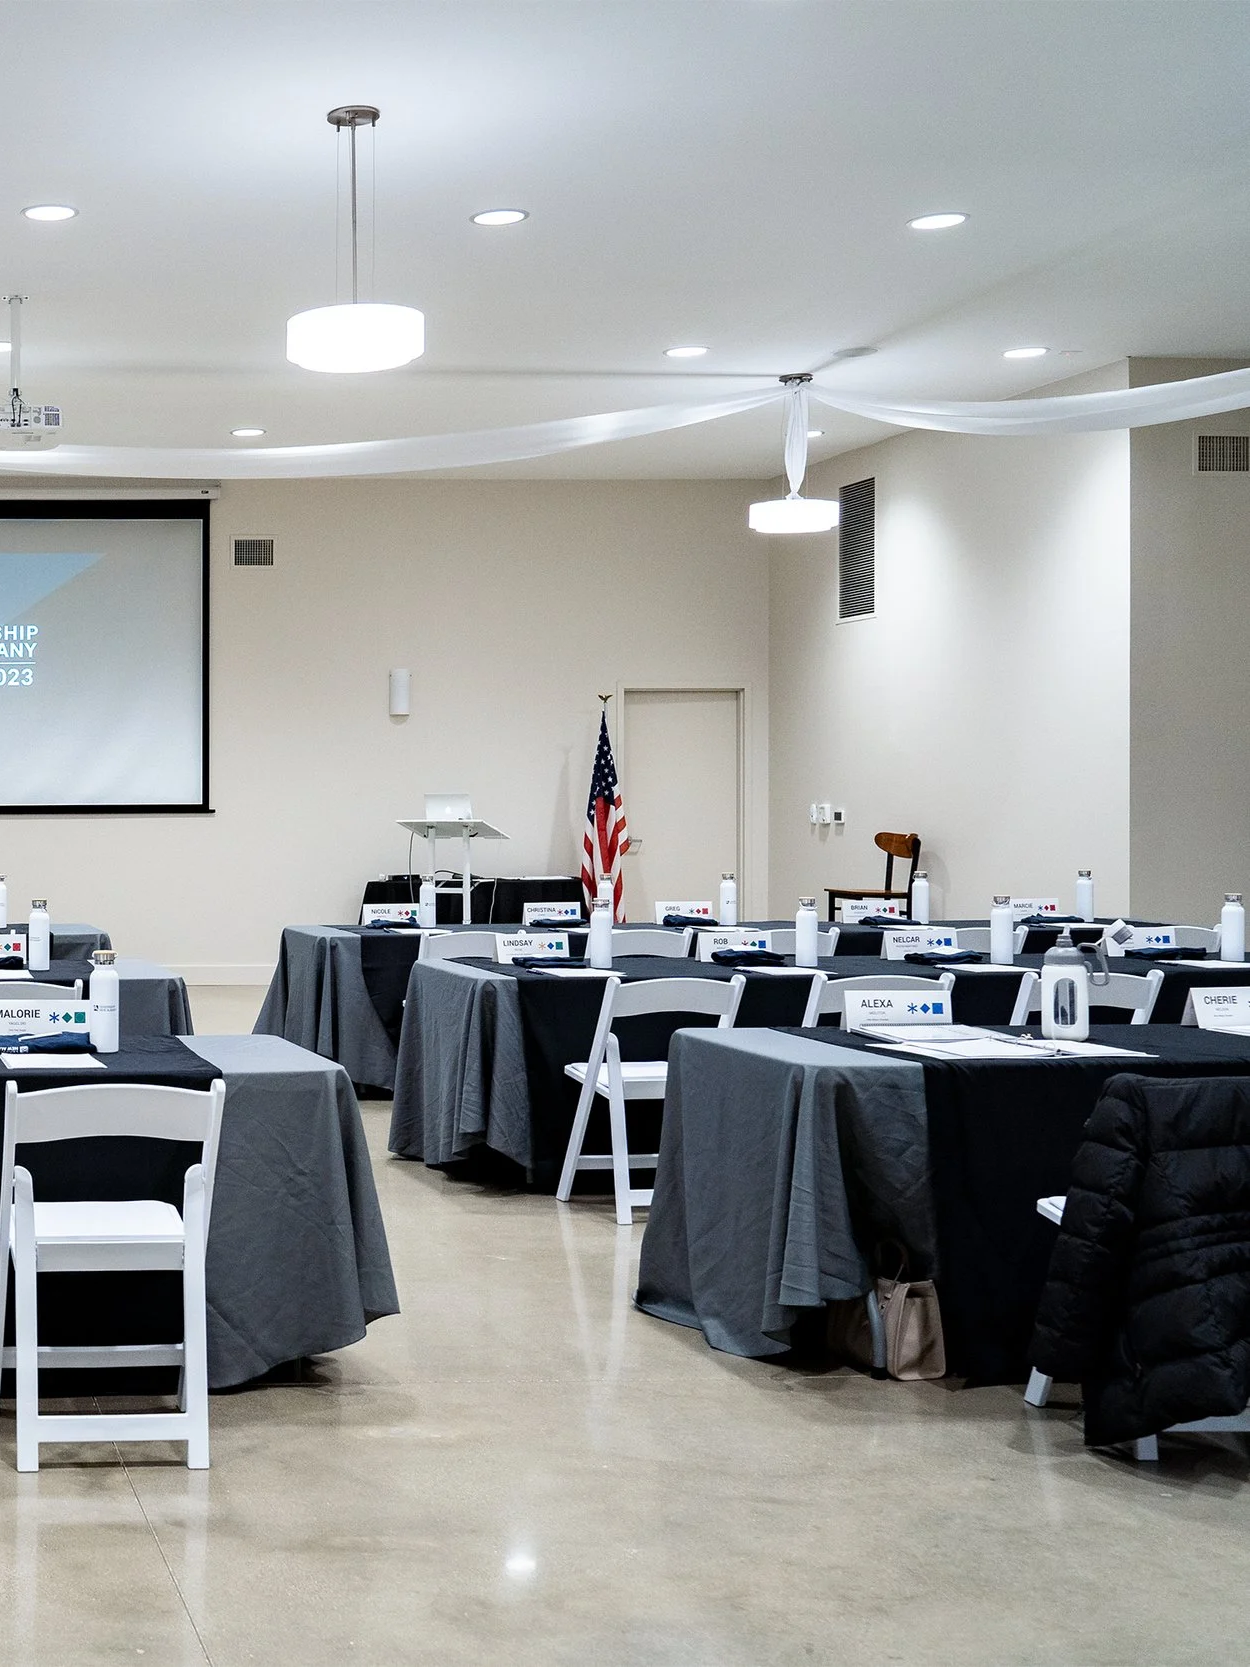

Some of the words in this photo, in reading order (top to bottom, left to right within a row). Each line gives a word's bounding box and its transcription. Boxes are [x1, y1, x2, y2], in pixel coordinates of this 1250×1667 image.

[502, 939, 533, 947] LINDSAY
[860, 999, 894, 1008] ALEXA
[1203, 995, 1238, 1005] CHERIE
